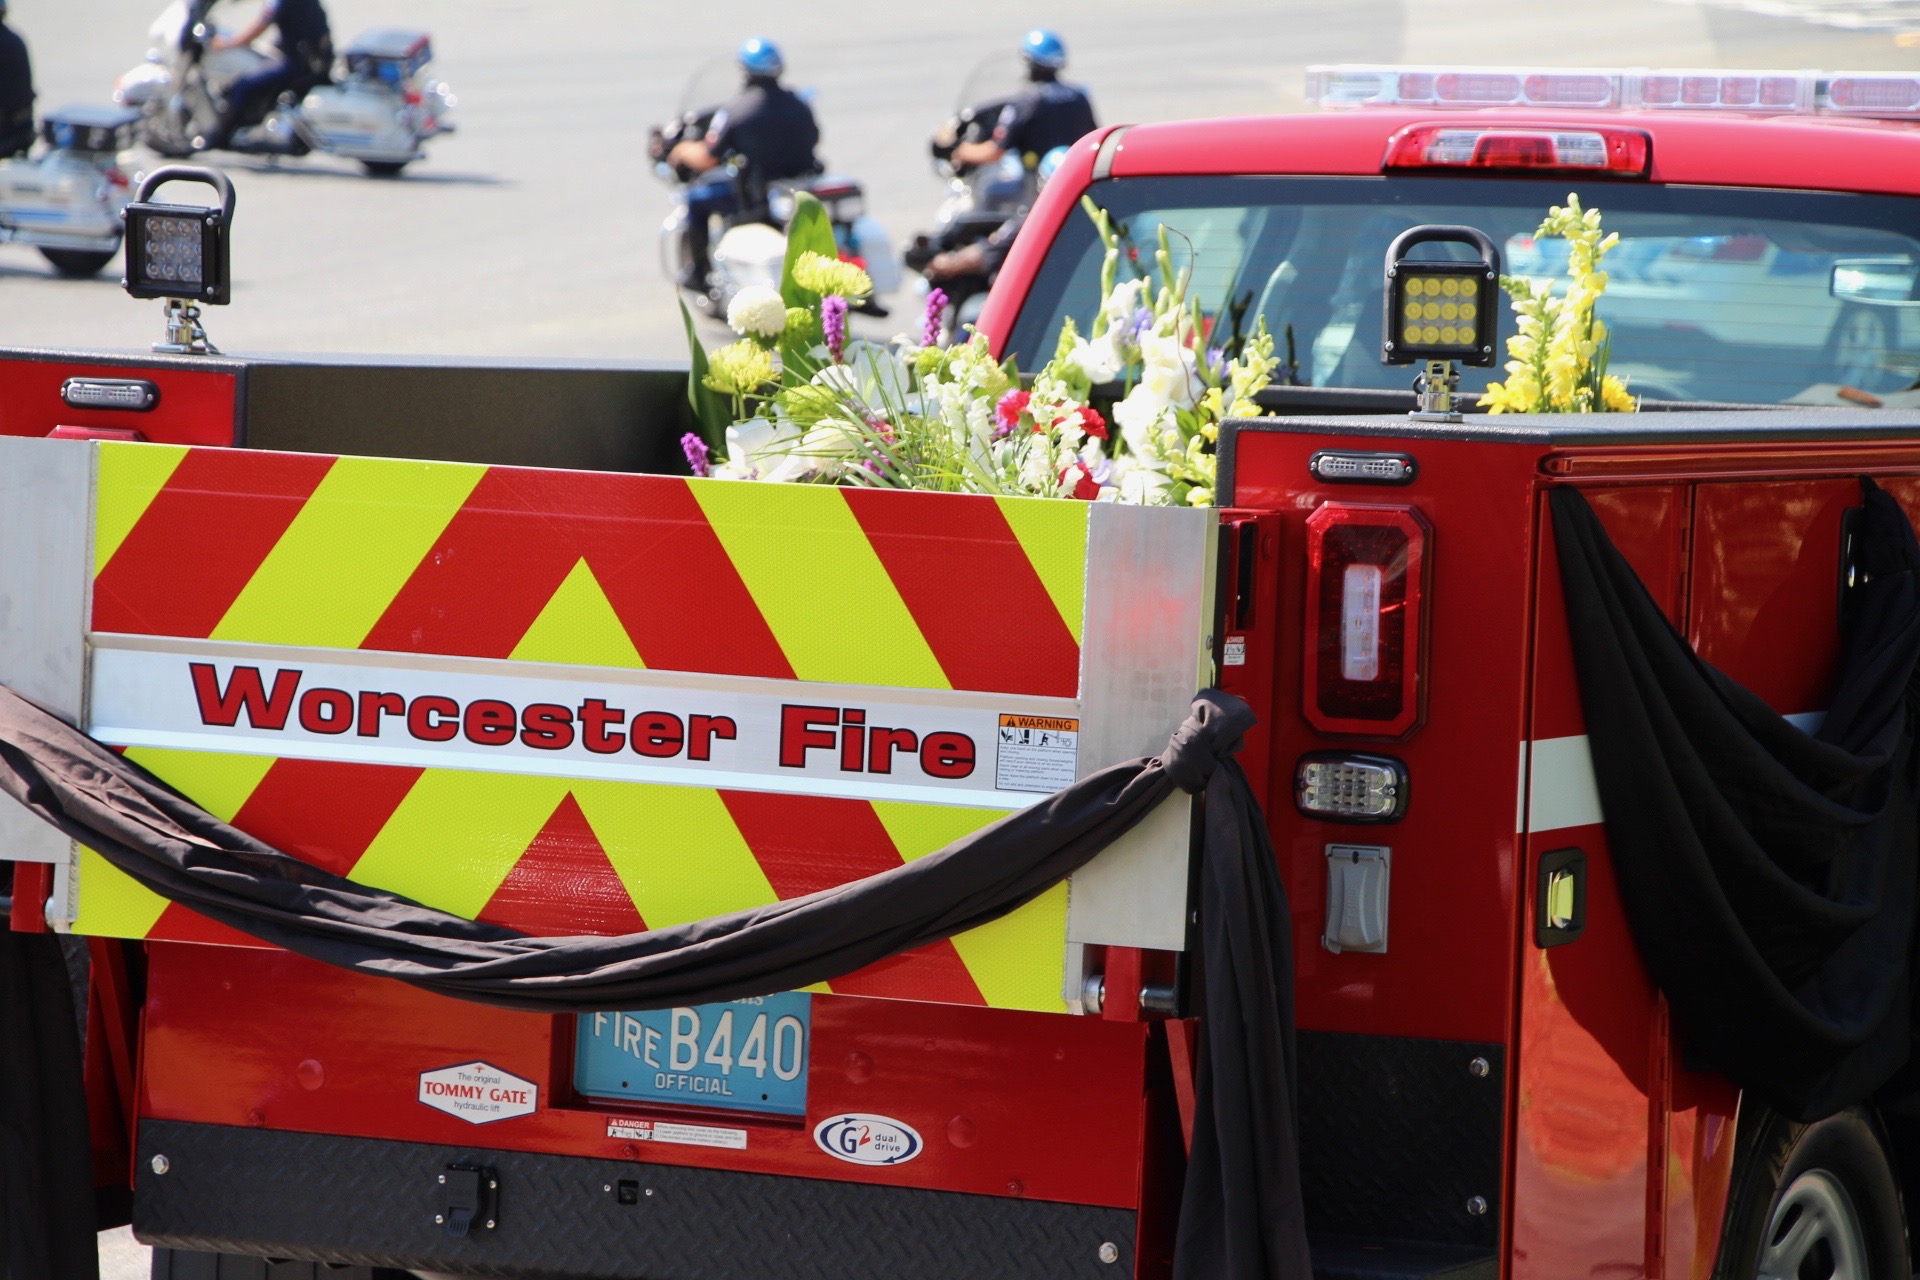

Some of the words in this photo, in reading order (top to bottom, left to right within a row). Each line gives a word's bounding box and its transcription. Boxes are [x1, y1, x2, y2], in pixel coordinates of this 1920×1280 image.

[189, 662, 738, 762] Worcester
[778, 703, 976, 780] Fire
[1018, 718, 1072, 730] WARNING
[594, 1011, 662, 1069] FIRE
[670, 1006, 803, 1082] B440
[458, 1072, 471, 1081] The
[474, 1074, 500, 1084] original
[655, 1072, 732, 1096] OFFICIAL
[424, 1081, 484, 1100] TOMMY
[454, 1100, 488, 1112] hydraulic
[490, 1104, 500, 1112] lift
[618, 1120, 649, 1129] DANGER
[840, 1125, 870, 1154] G2
[875, 1134, 897, 1142] dual
[875, 1142, 900, 1152] drive
